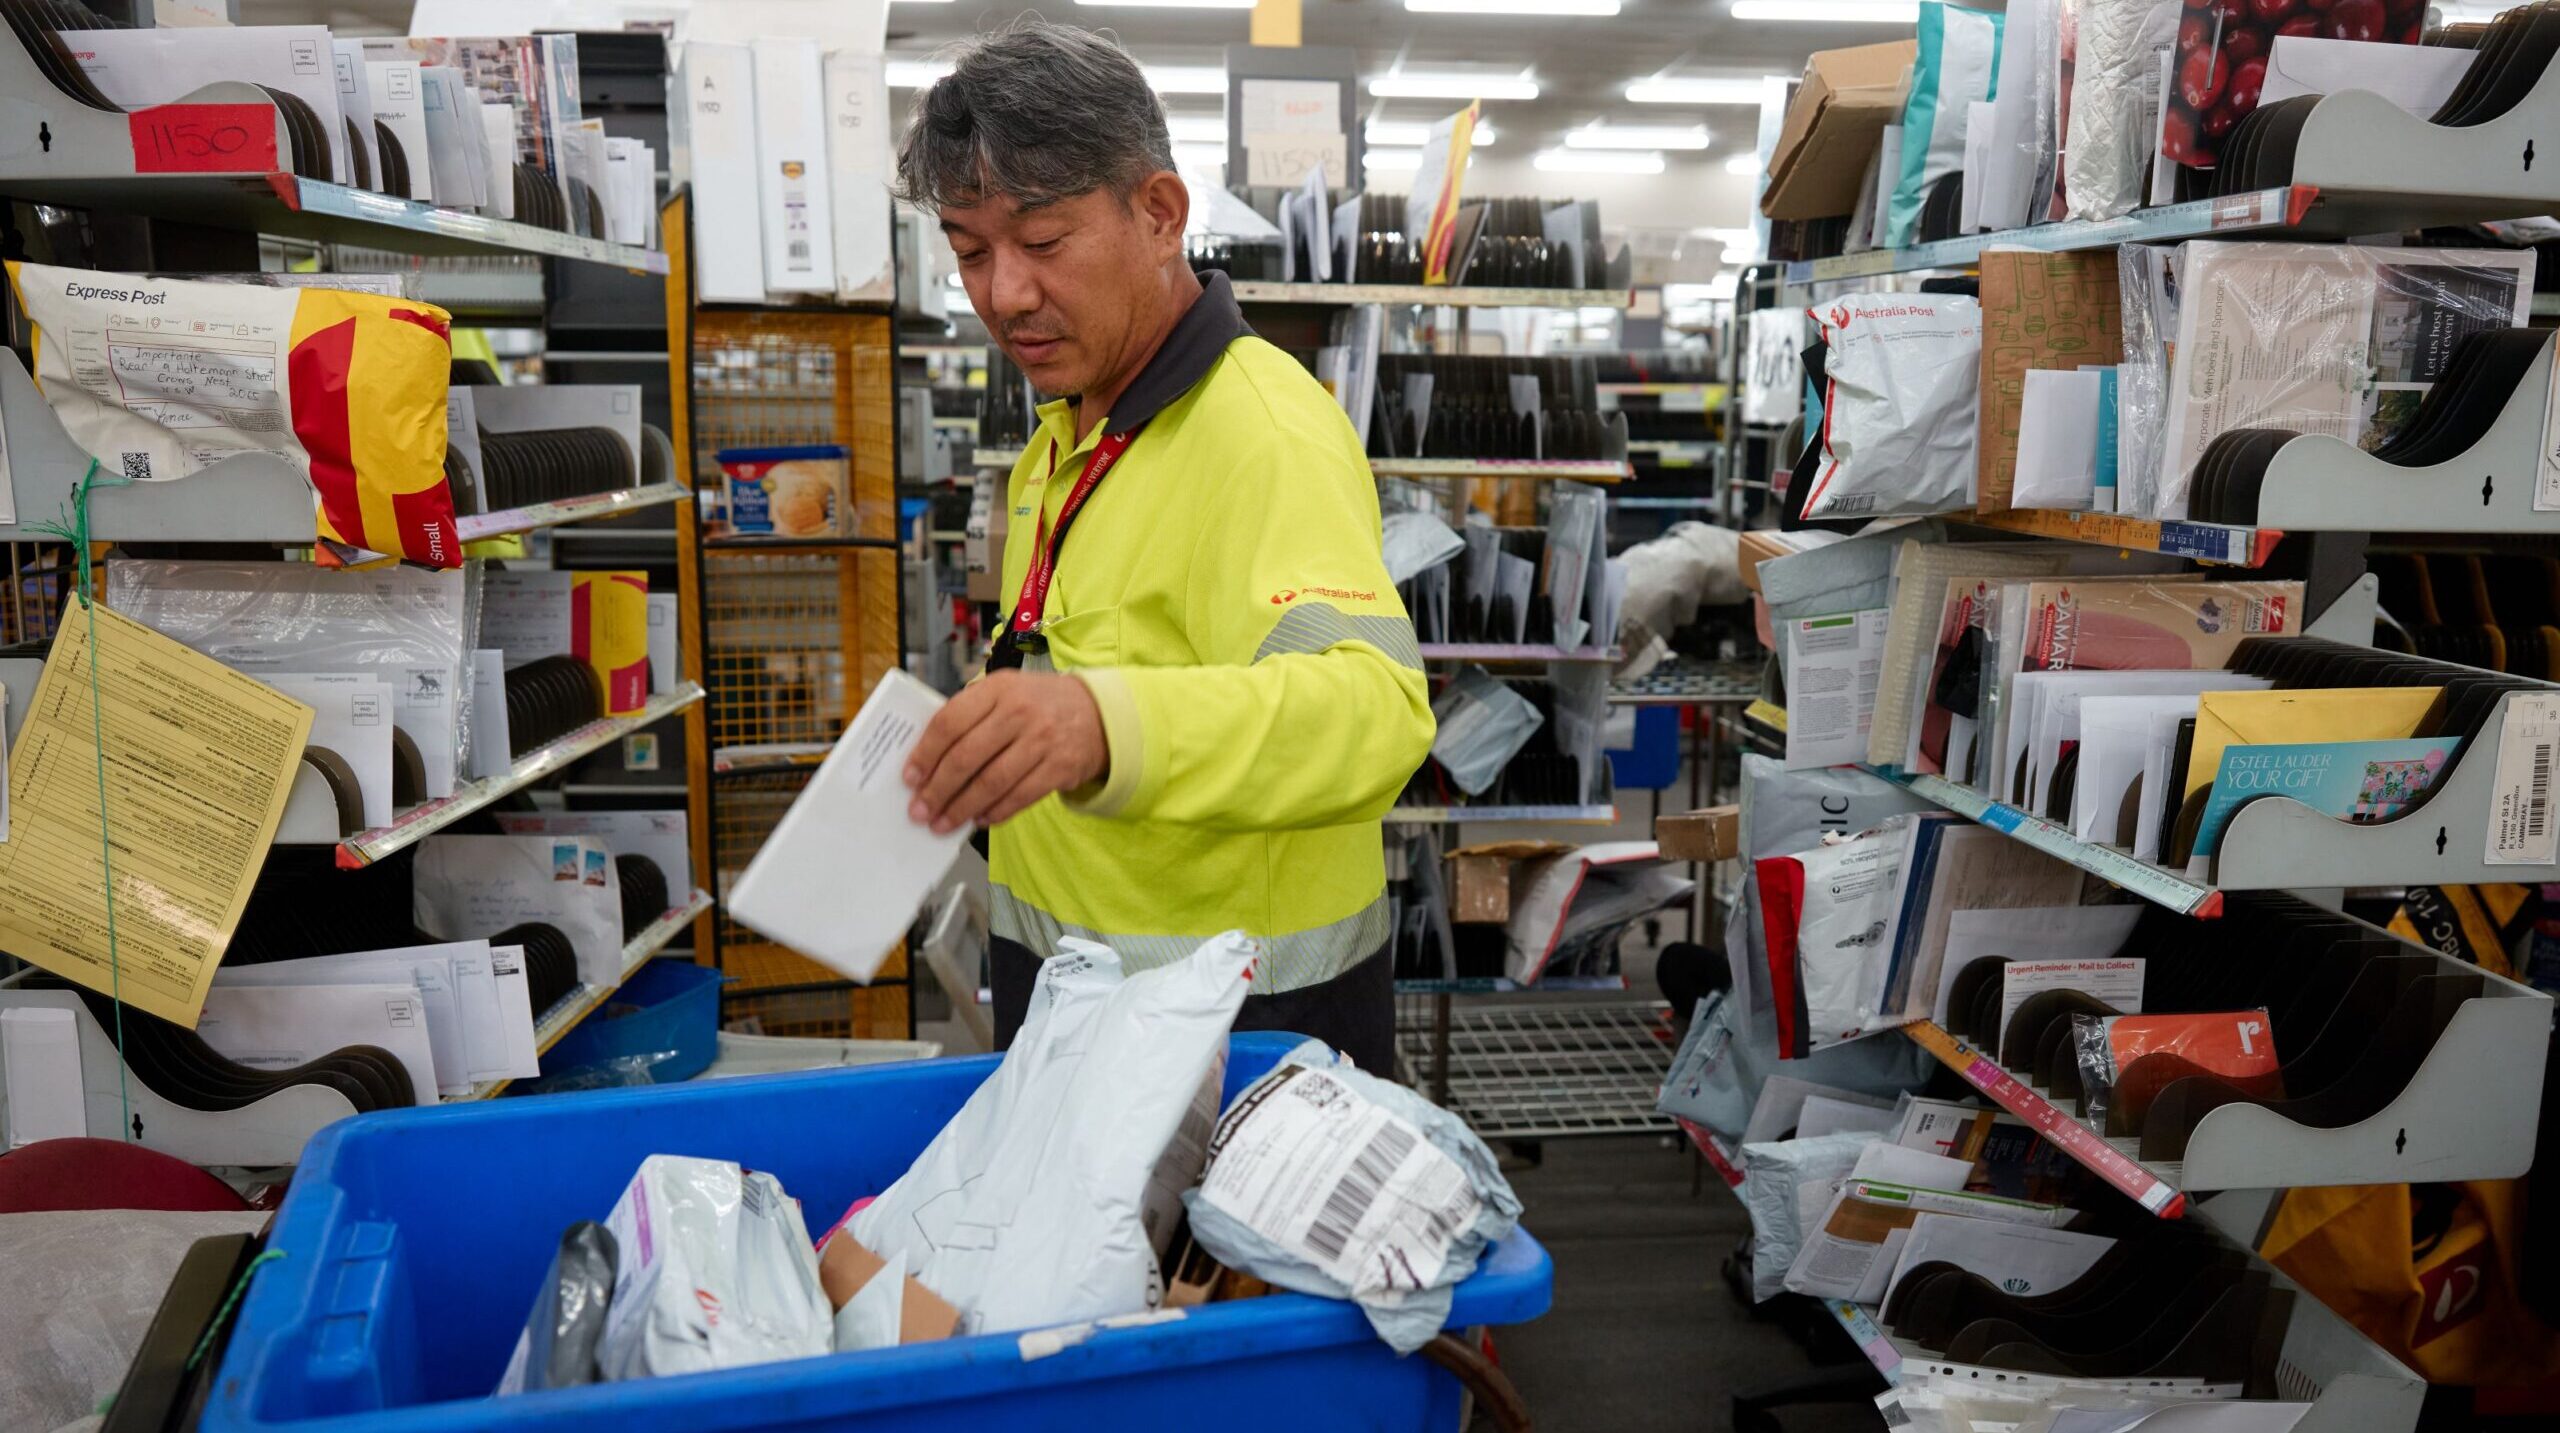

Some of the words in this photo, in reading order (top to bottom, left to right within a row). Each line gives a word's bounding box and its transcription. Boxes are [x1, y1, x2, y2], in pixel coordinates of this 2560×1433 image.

[71, 50, 96, 62] eorge
[150, 123, 249, 163] 1150
[65, 282, 129, 302] Express
[130, 290, 168, 306] Post
[1855, 306, 1907, 319] Australia
[1909, 305, 1935, 318] Post
[2429, 314, 2441, 340] host
[2441, 313, 2455, 343] event
[136, 347, 202, 362] Importante
[2428, 339, 2438, 353] us
[119, 357, 149, 371] Rear
[245, 367, 274, 381] Street
[2423, 354, 2436, 377] Let
[205, 376, 231, 387] Nest
[1086, 450, 1113, 483] EVERYONE
[423, 521, 445, 562] Small
[1351, 590, 1377, 601] Post
[1969, 580, 1985, 628] DAM
[2048, 586, 2072, 671] DAMAR
[2550, 710, 2557, 720] 35
[2274, 753, 2333, 768] LAUDER
[2227, 768, 2281, 790] YOUR
[2285, 767, 2330, 788] GIFT
[2503, 794, 2511, 805] 2A
[2501, 807, 2509, 817] St
[2499, 819, 2509, 850] Palmer
[2518, 803, 2529, 849] CAMMERAY
[2007, 966, 2034, 976] Urgent
[2034, 963, 2072, 973] Reminder
[2078, 962, 2095, 971] Mail
[2105, 961, 2136, 971] Collect
[2237, 1021, 2260, 1055] r
